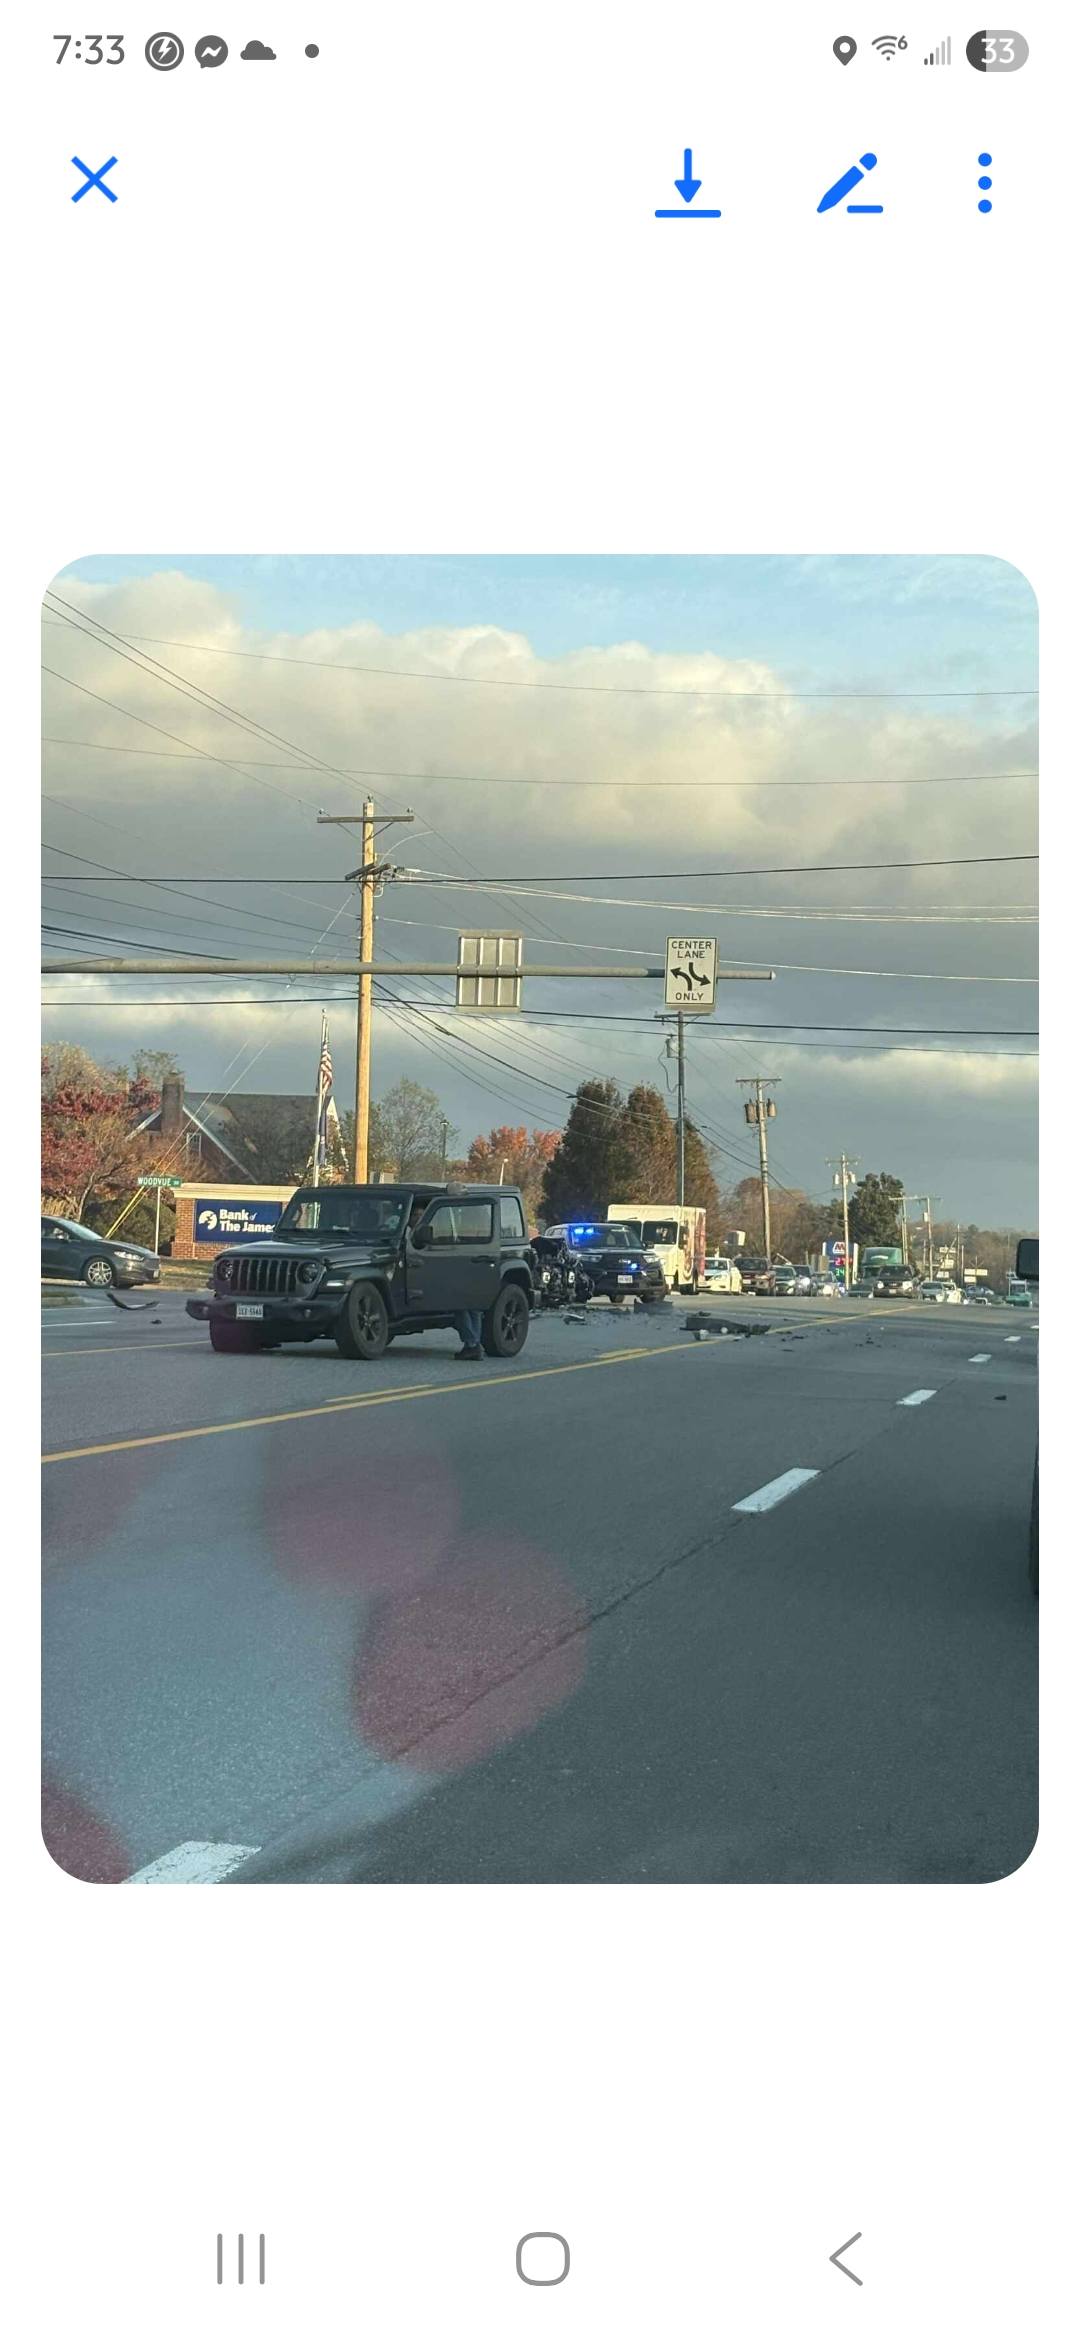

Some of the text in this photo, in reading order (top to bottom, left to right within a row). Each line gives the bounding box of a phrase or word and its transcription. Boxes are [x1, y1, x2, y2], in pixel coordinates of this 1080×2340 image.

[671, 941, 712, 949] CENTER
[677, 951, 705, 959] LANE
[675, 992, 704, 1001] ONLY
[137, 1177, 171, 1186] WOODVUE
[219, 1209, 250, 1220] Bank
[220, 1220, 241, 1232] The
